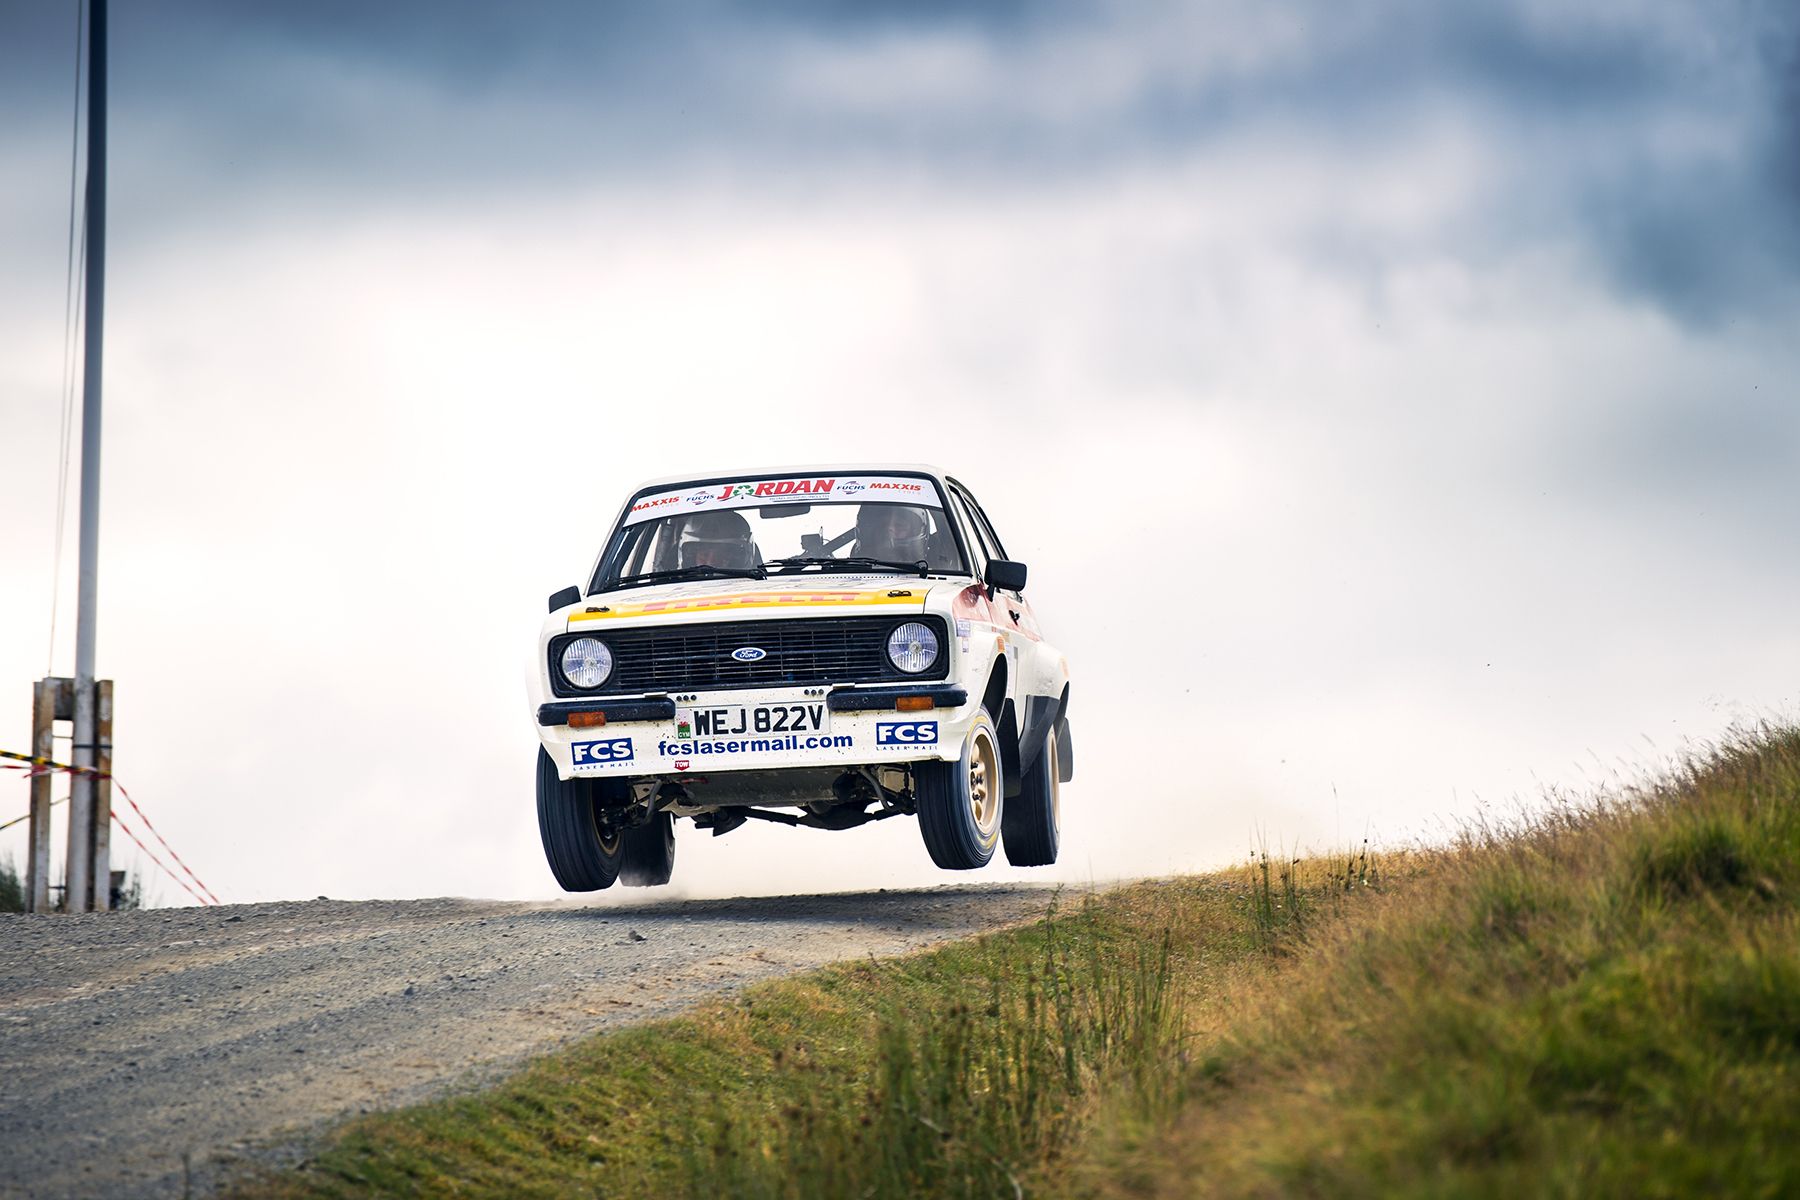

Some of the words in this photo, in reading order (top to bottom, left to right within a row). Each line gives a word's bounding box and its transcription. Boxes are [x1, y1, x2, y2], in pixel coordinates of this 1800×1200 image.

[717, 479, 836, 501] JORDAN
[869, 482, 922, 491] MAXXIS
[630, 496, 680, 512] MAXXIS
[686, 494, 714, 502] FUCHS
[693, 708, 747, 736] WEJ
[753, 705, 824, 733] 822V
[878, 724, 936, 742] FCS
[573, 741, 631, 762] FCS
[658, 735, 853, 756] fcslasermail.com
[573, 764, 604, 772] LASER
